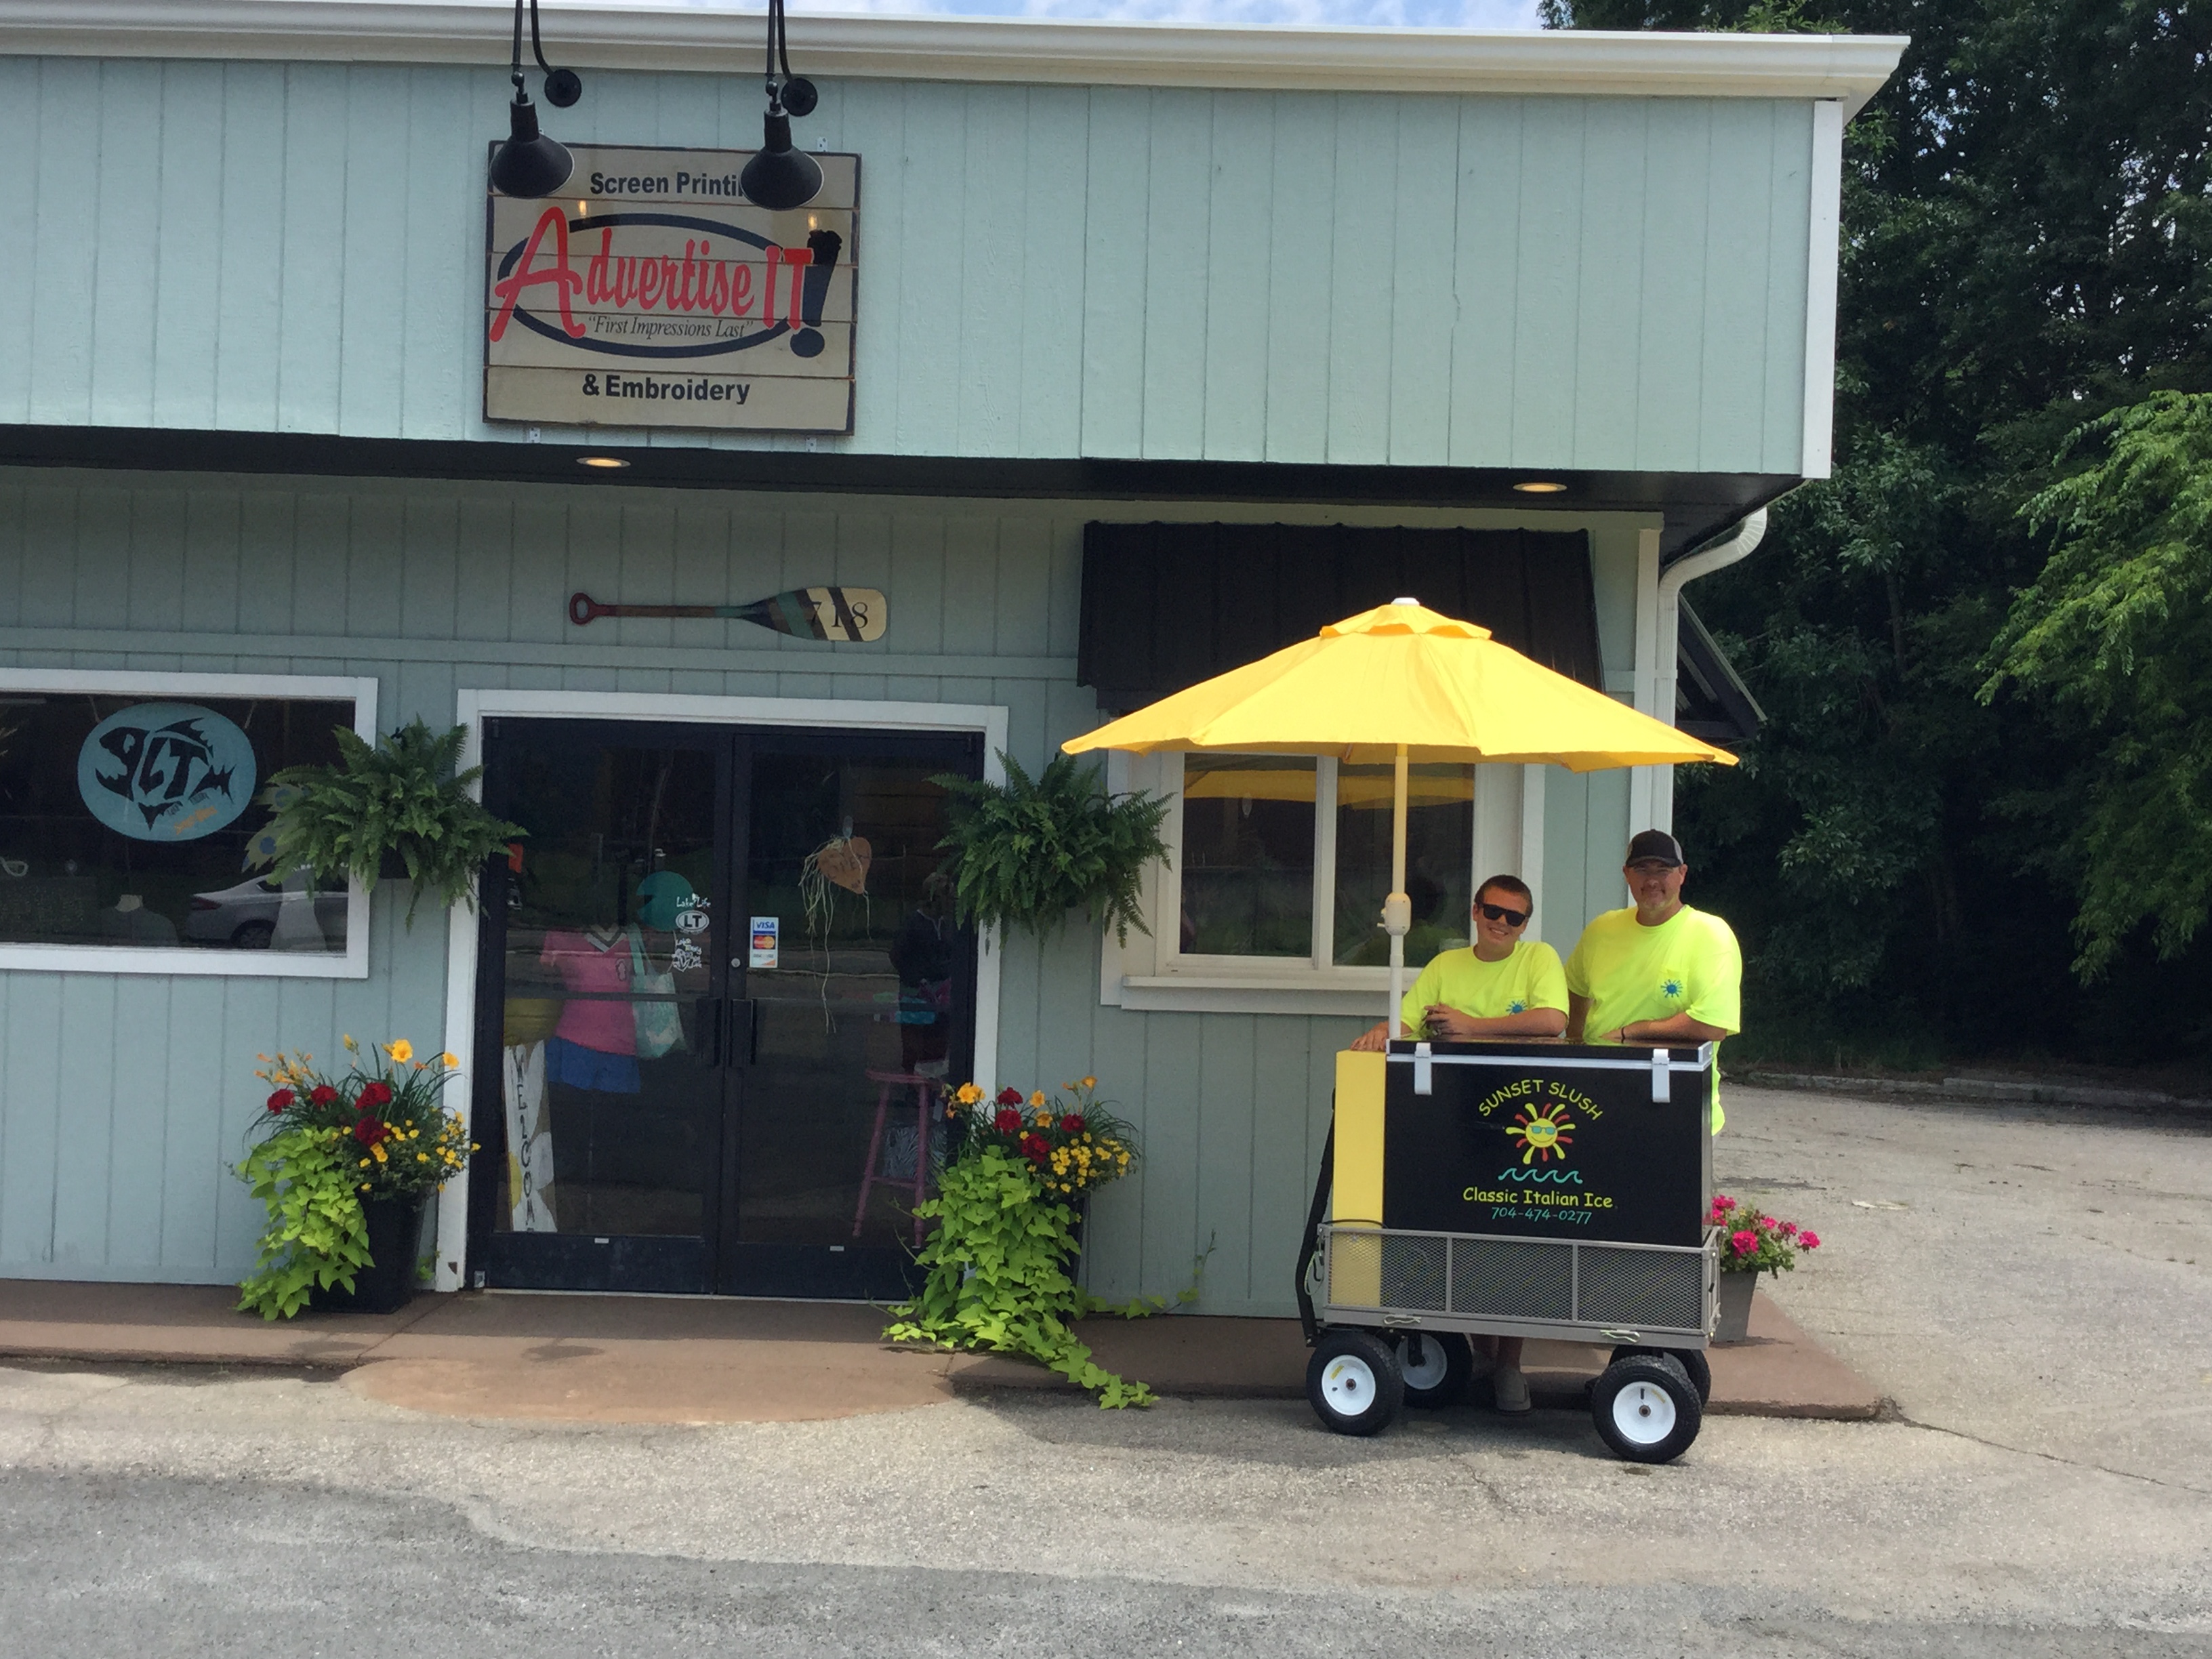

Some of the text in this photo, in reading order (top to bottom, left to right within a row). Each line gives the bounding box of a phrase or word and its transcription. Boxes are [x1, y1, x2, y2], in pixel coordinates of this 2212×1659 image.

[590, 172, 744, 197] Screen Printi
[490, 206, 755, 342] Advertise
[631, 317, 712, 340] Impressions
[581, 373, 750, 405] & Embroidery
[684, 914, 702, 928] LT
[756, 920, 775, 929] VISA
[1478, 1079, 1603, 1122] SUNSET SLUSH
[513, 1048, 535, 1232] WELCOM
[1462, 1187, 1613, 1208] Classic Italian Ice
[1491, 1206, 1593, 1225] 704-474-0277
